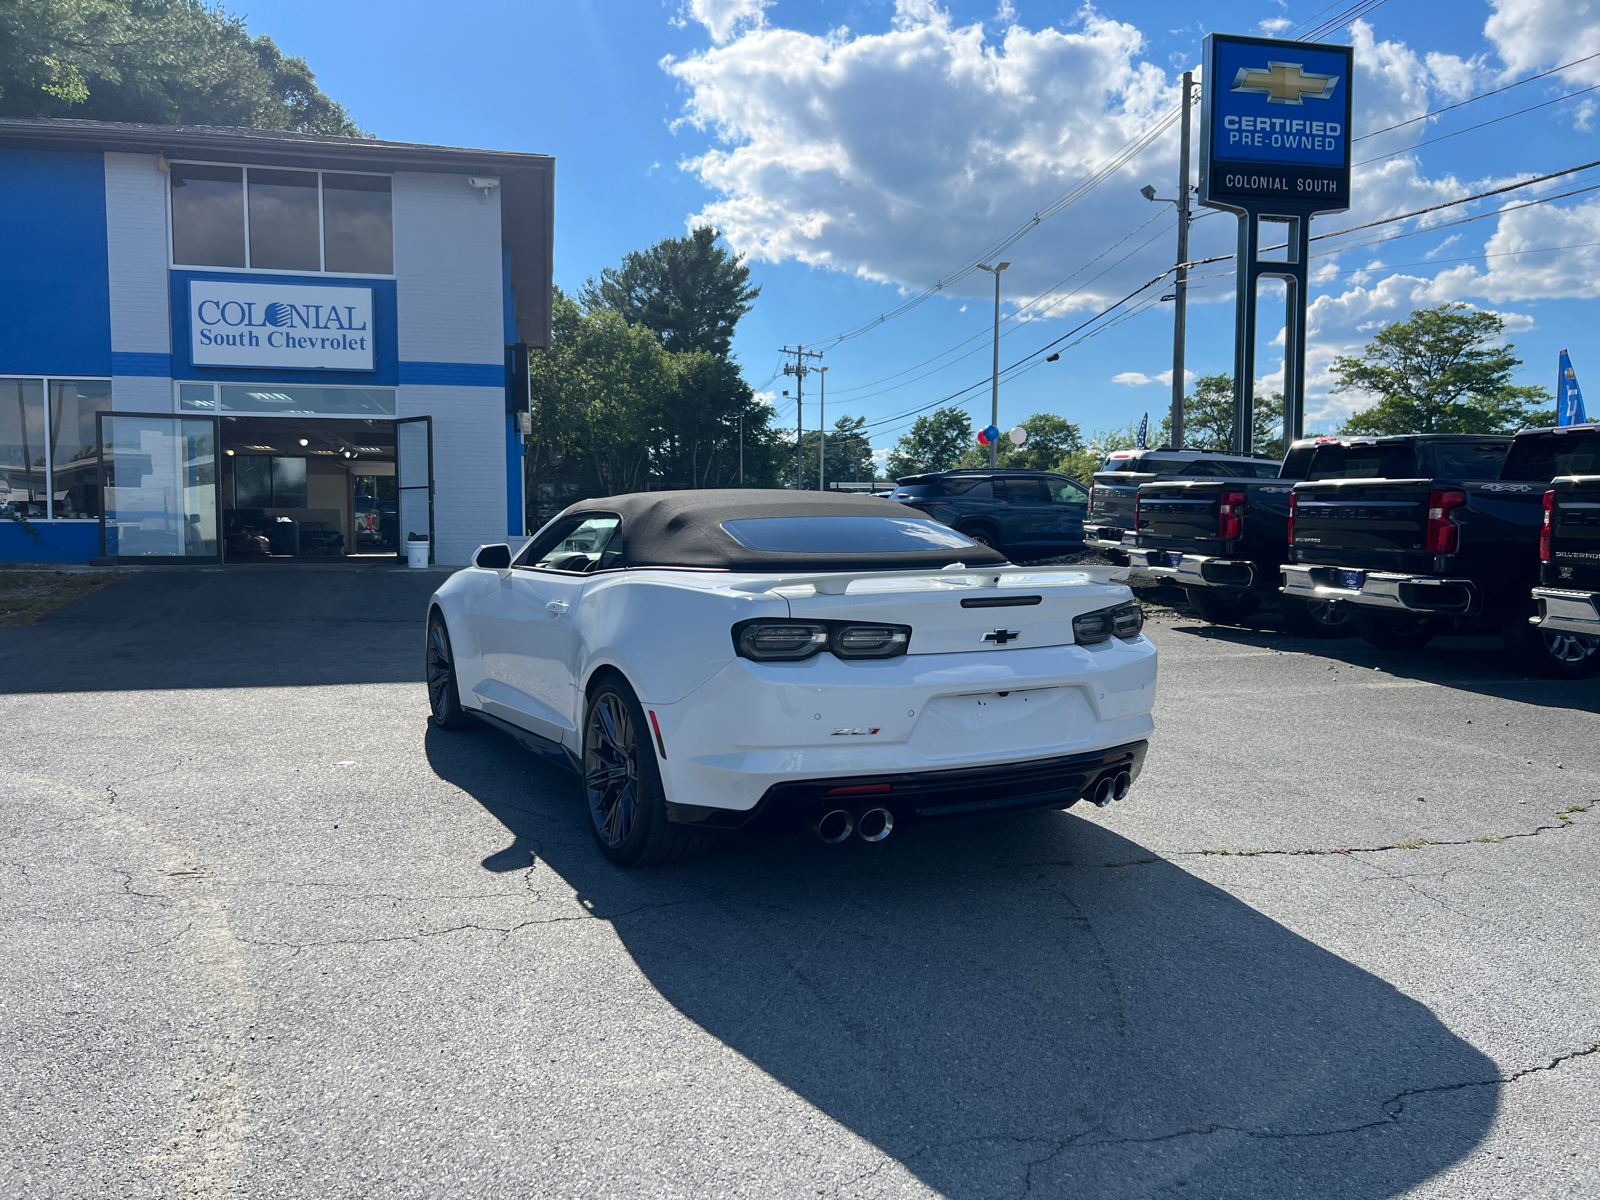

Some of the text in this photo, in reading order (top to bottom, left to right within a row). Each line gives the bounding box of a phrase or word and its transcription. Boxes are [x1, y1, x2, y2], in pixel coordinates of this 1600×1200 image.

[1224, 115, 1341, 137] CERTIFIED
[1229, 131, 1336, 151] PRE-OWNED
[1225, 174, 1337, 193] COLONIAL SOUTH
[197, 299, 367, 331] COLONIAL
[199, 328, 367, 351] South Chevrolet
[1297, 508, 1415, 519] CHEVROLET
